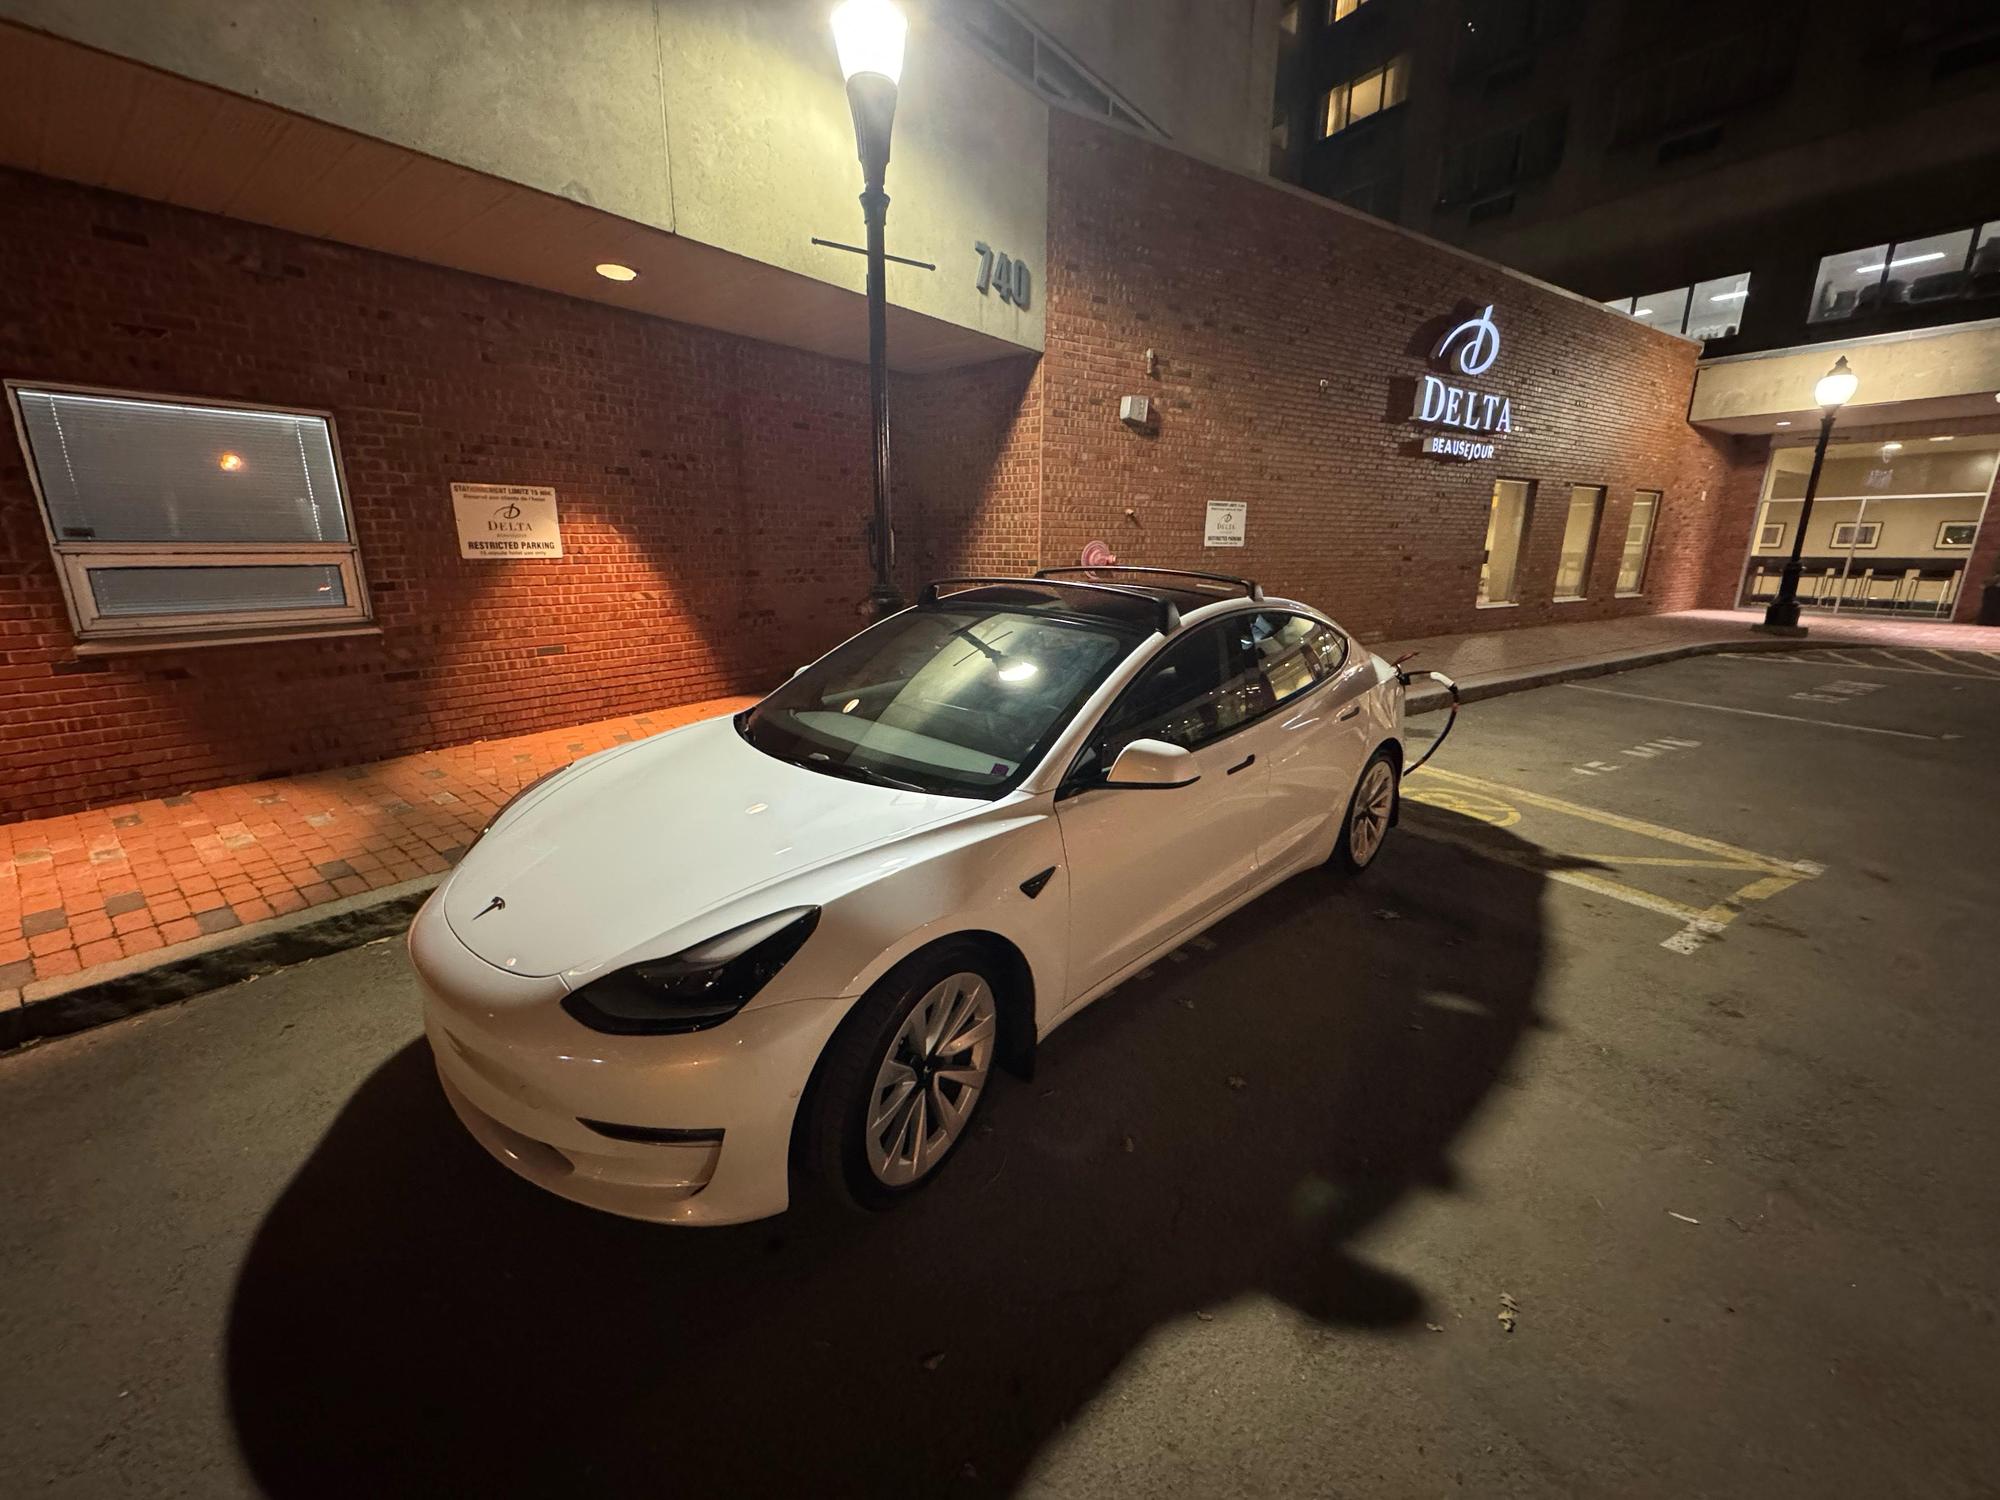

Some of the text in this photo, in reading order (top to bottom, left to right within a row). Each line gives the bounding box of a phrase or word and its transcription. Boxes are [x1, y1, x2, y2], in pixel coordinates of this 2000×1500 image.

[975, 240, 1031, 312] 740
[1419, 375, 1511, 433] DELTA
[488, 521, 532, 532] DELTA
[468, 541, 555, 550] RESTRICTED PARKING
